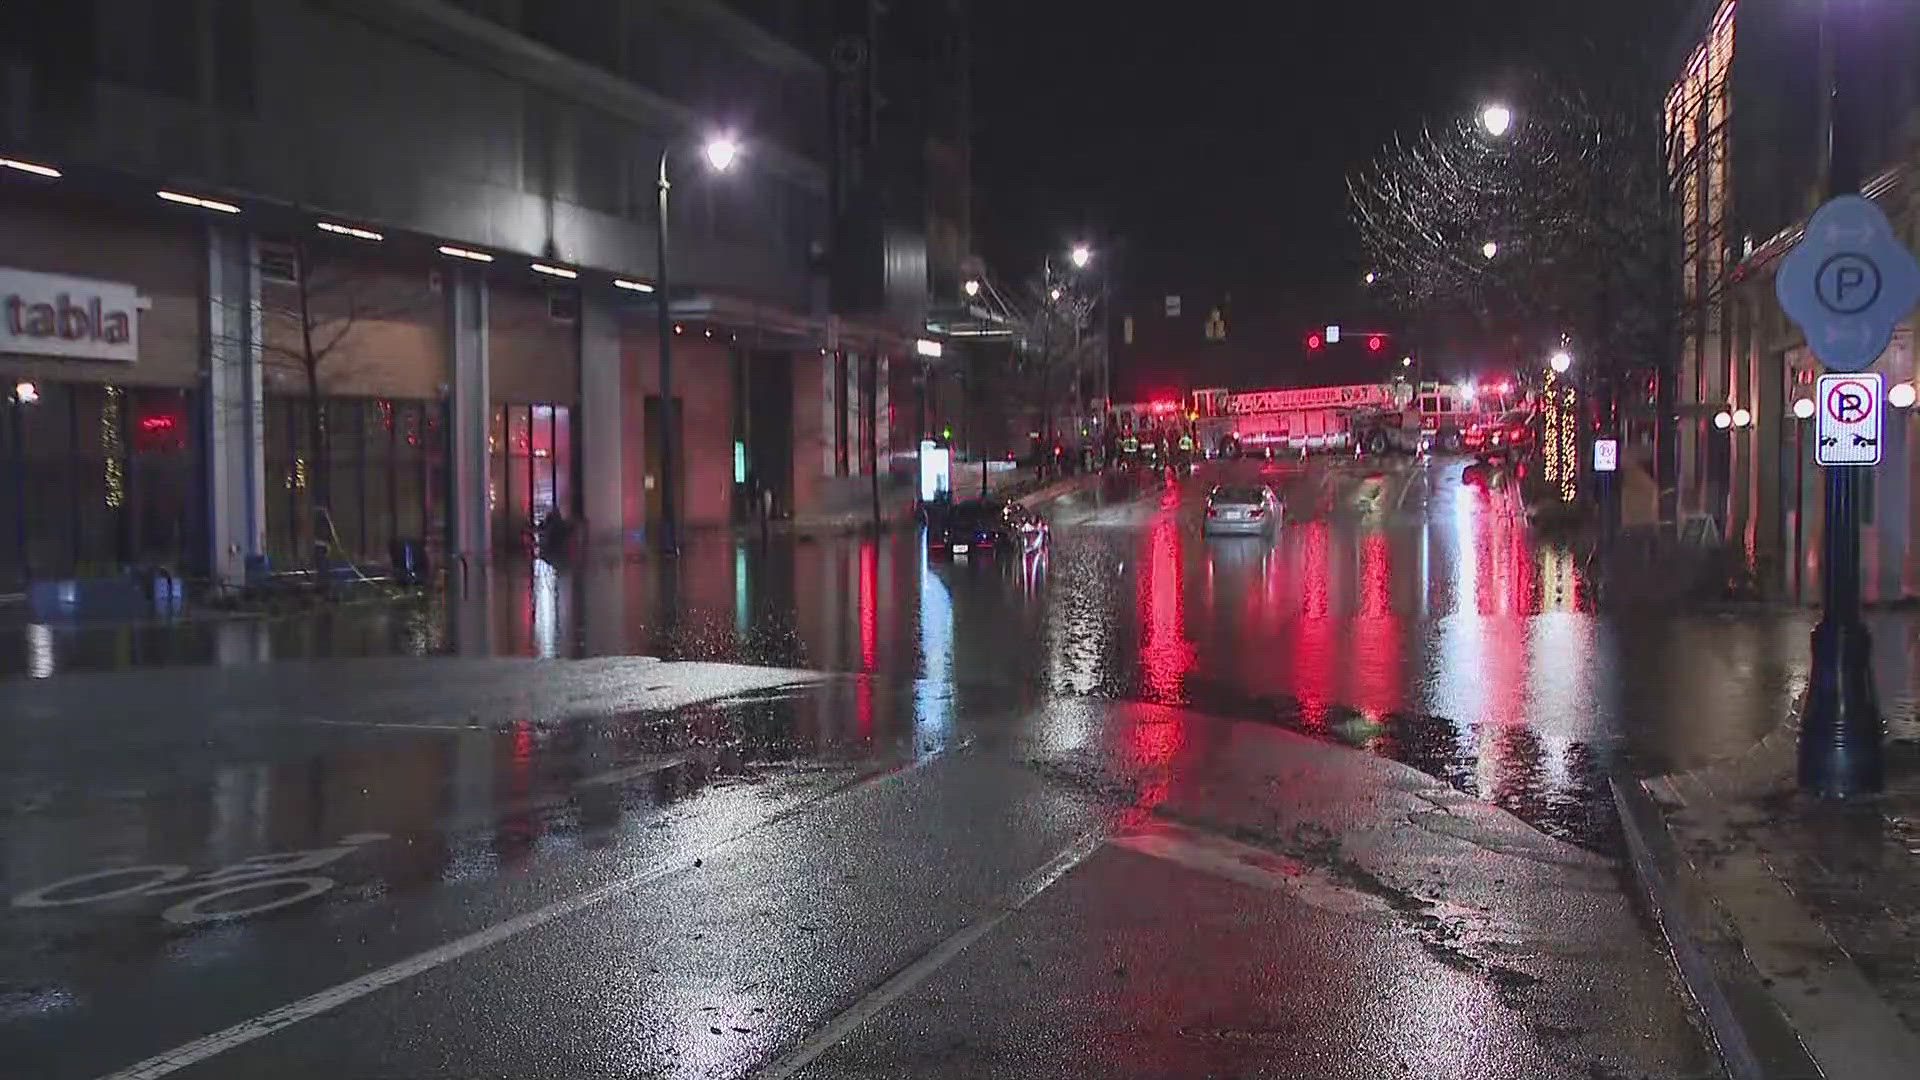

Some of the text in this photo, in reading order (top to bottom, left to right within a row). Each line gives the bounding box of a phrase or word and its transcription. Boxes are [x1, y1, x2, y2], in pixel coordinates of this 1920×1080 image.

[1837, 267, 1863, 301] P
[7, 292, 130, 344] tabla
[1839, 394, 1861, 421] P
